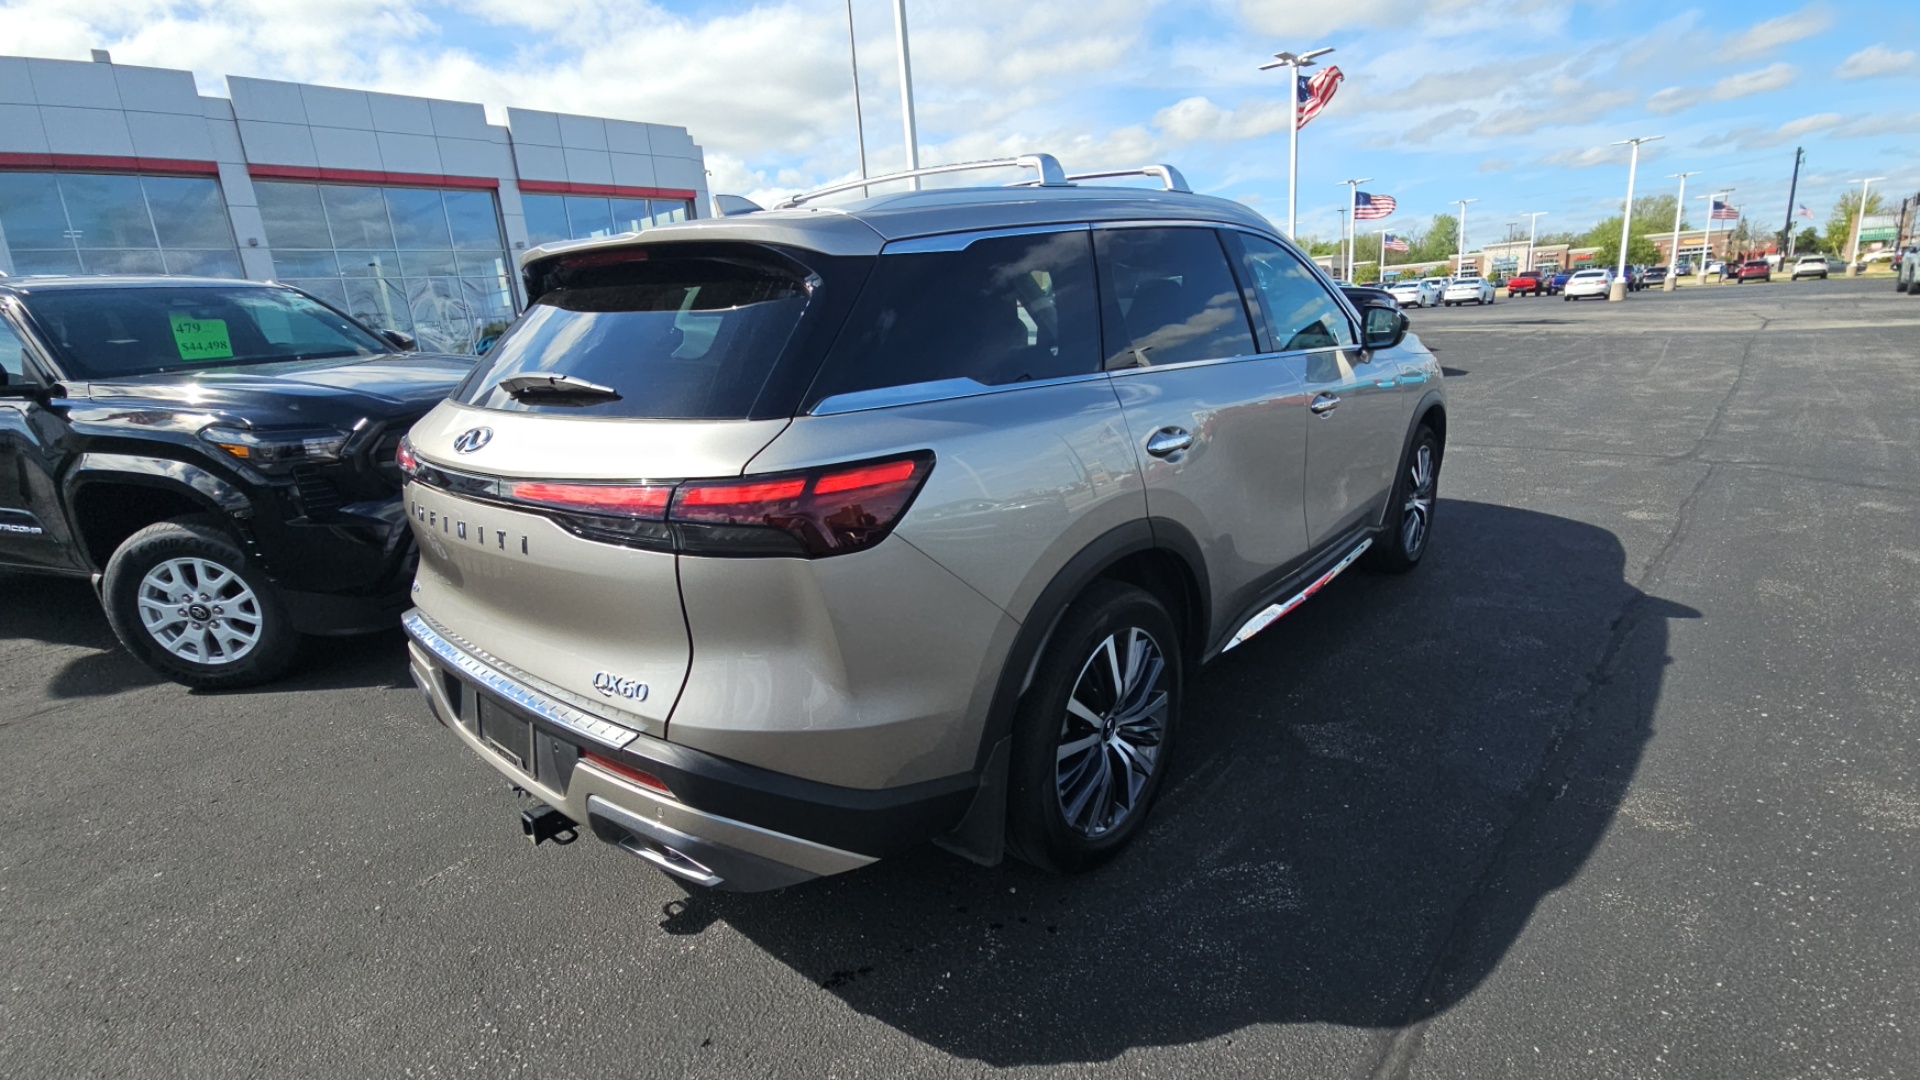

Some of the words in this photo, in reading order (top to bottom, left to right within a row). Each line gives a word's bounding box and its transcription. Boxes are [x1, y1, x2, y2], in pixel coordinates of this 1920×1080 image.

[176, 322, 201, 333] 479
[181, 340, 228, 352] $44,498
[411, 500, 529, 555] INFINITI
[592, 670, 650, 702] QX60
